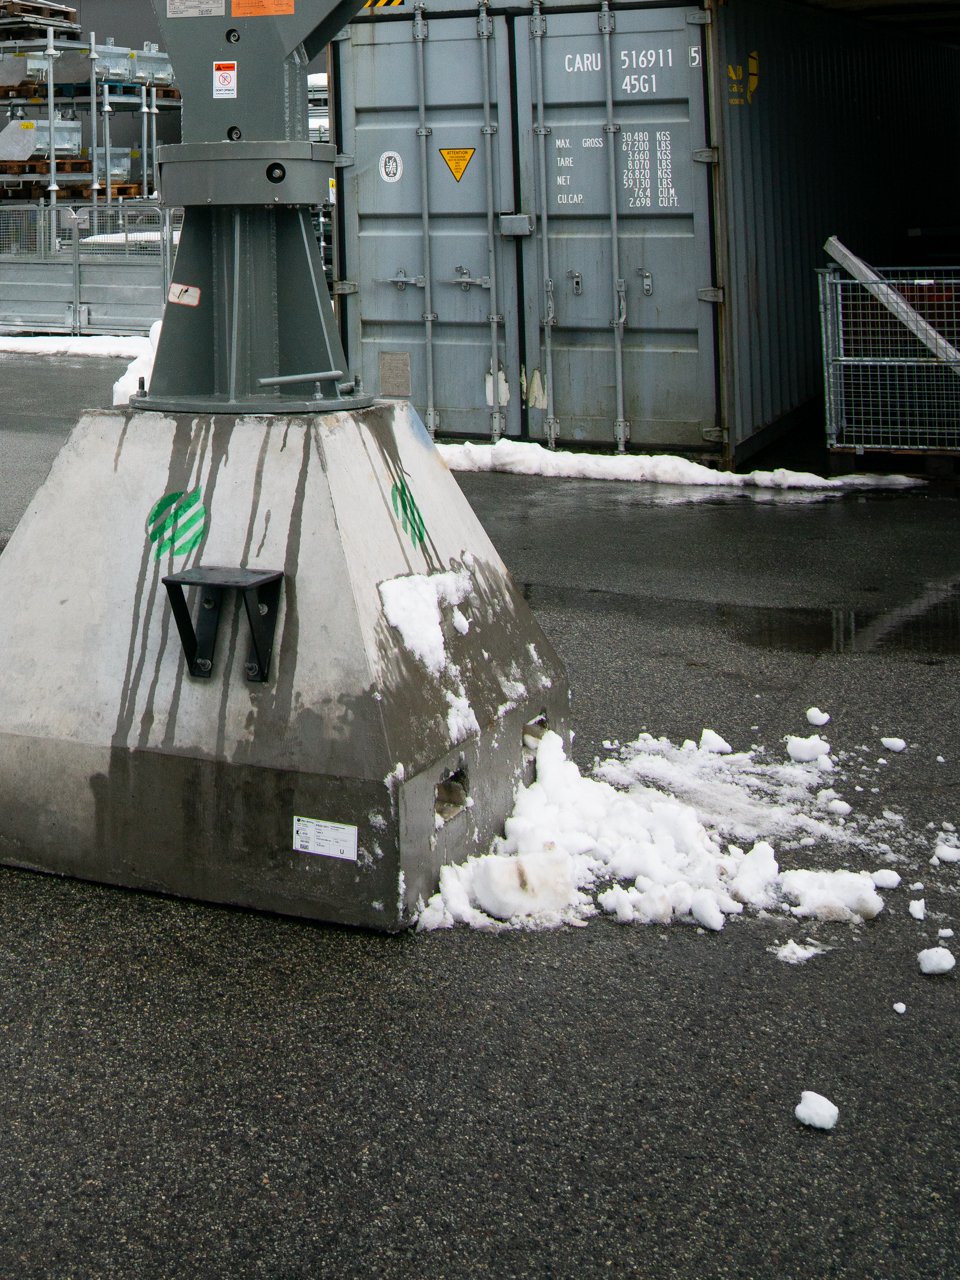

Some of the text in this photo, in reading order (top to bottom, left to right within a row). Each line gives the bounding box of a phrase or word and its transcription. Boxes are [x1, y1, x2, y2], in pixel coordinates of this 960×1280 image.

[564, 47, 700, 72] CARU 516911 5
[621, 74, 657, 93] 45G1
[621, 131, 671, 142] 30.480 KGS
[555, 138, 604, 149] MAX. GROSS
[622, 141, 671, 151] 67.200 LBS
[627, 150, 672, 160] 3.660 KGS
[557, 157, 574, 167] TARE
[627, 159, 672, 169] 8.070 LBS
[623, 169, 672, 179] 26.820 KGS
[556, 175, 571, 185] NET
[623, 179, 673, 188] 59.130 LBS
[633, 188, 651, 197] 76.4
[557, 194, 584, 204] CU.CAP.
[629, 197, 680, 207] 2.698 CU.FT.
